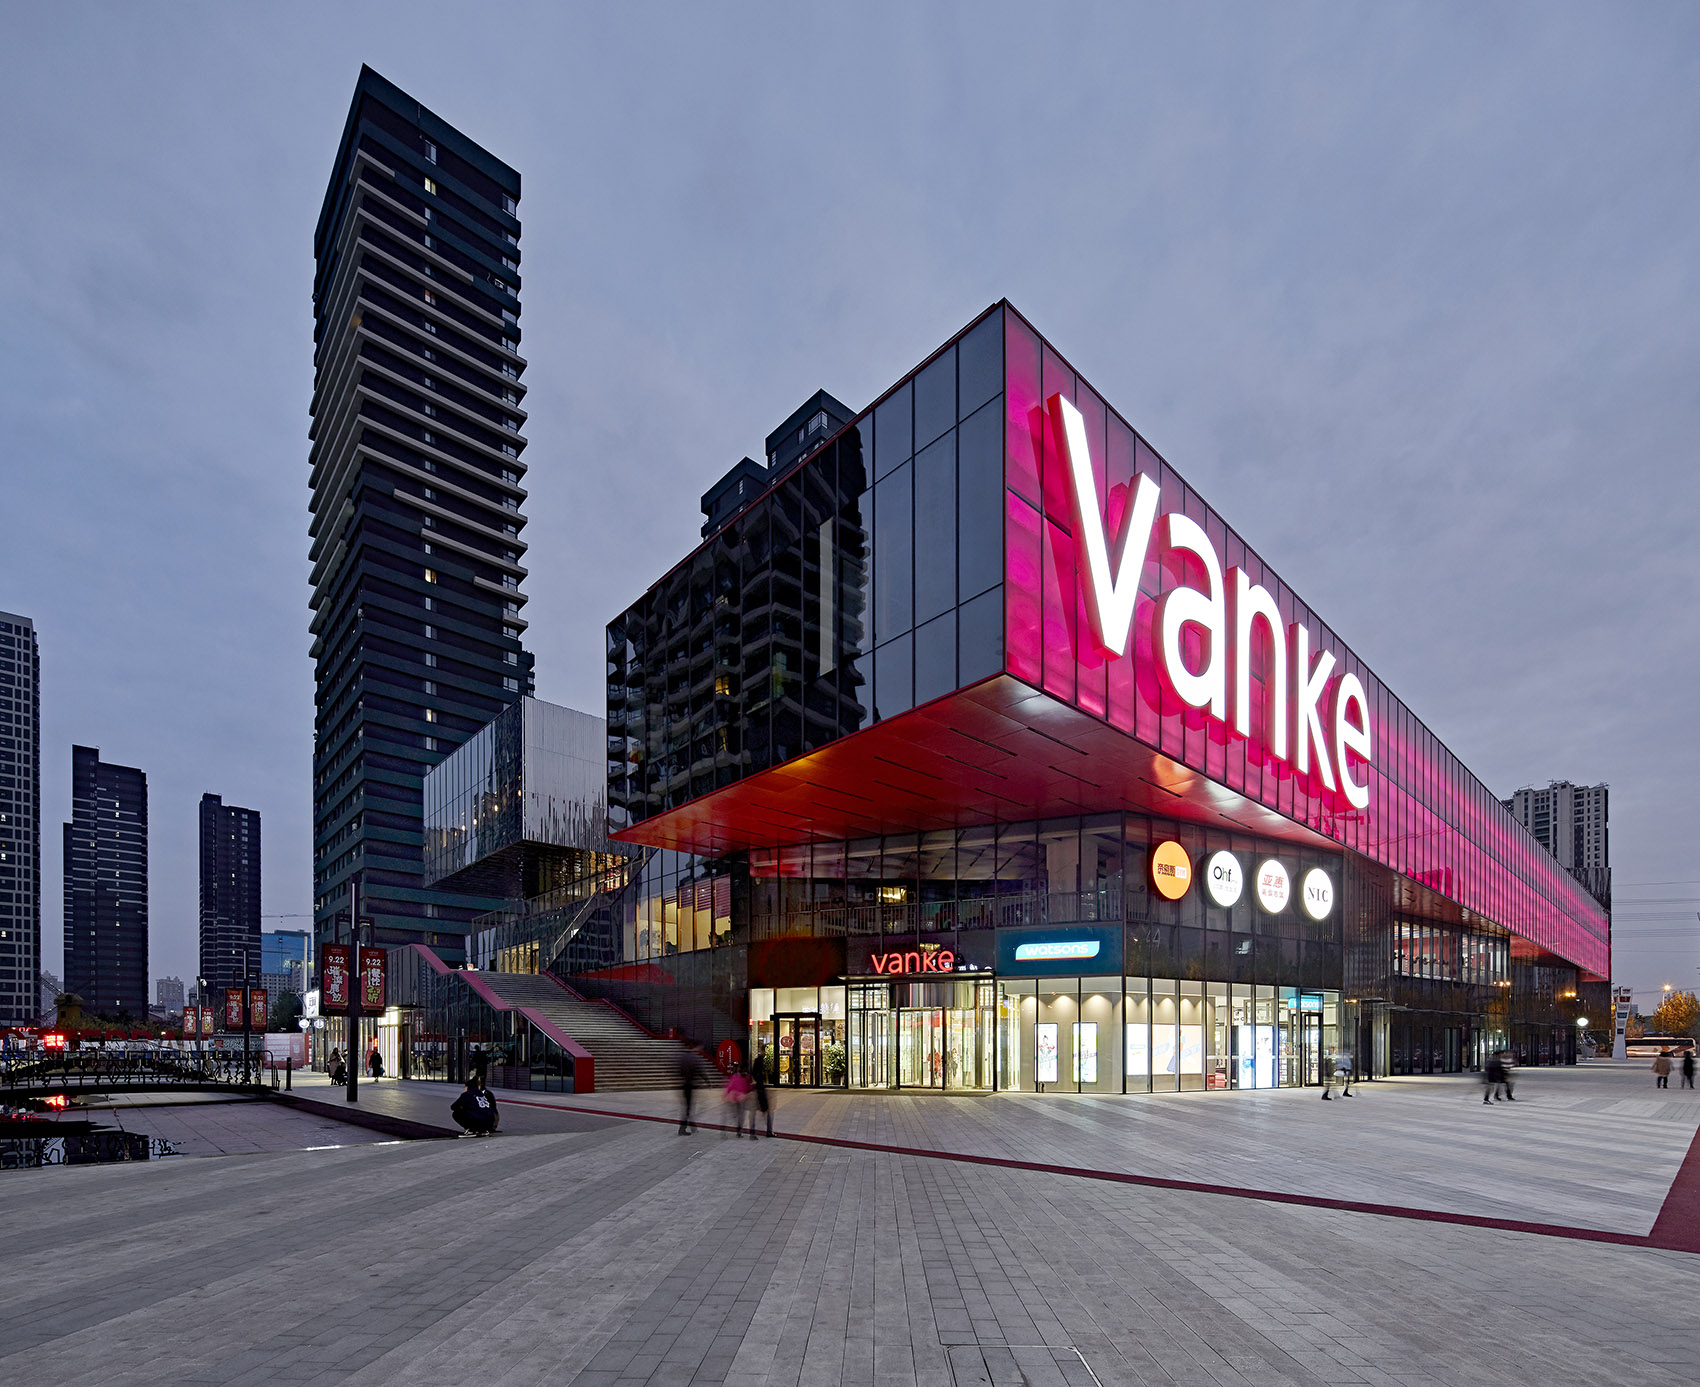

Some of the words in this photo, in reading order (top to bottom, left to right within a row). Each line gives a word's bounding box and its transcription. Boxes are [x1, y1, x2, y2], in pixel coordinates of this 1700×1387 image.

[1261, 873, 1285, 889] 亚惠
[1307, 886, 1329, 903] NIC
[1025, 943, 1088, 956] watsons
[328, 955, 345, 964] 9.22
[365, 958, 381, 966] 9.22
[871, 950, 954, 974] vanke
